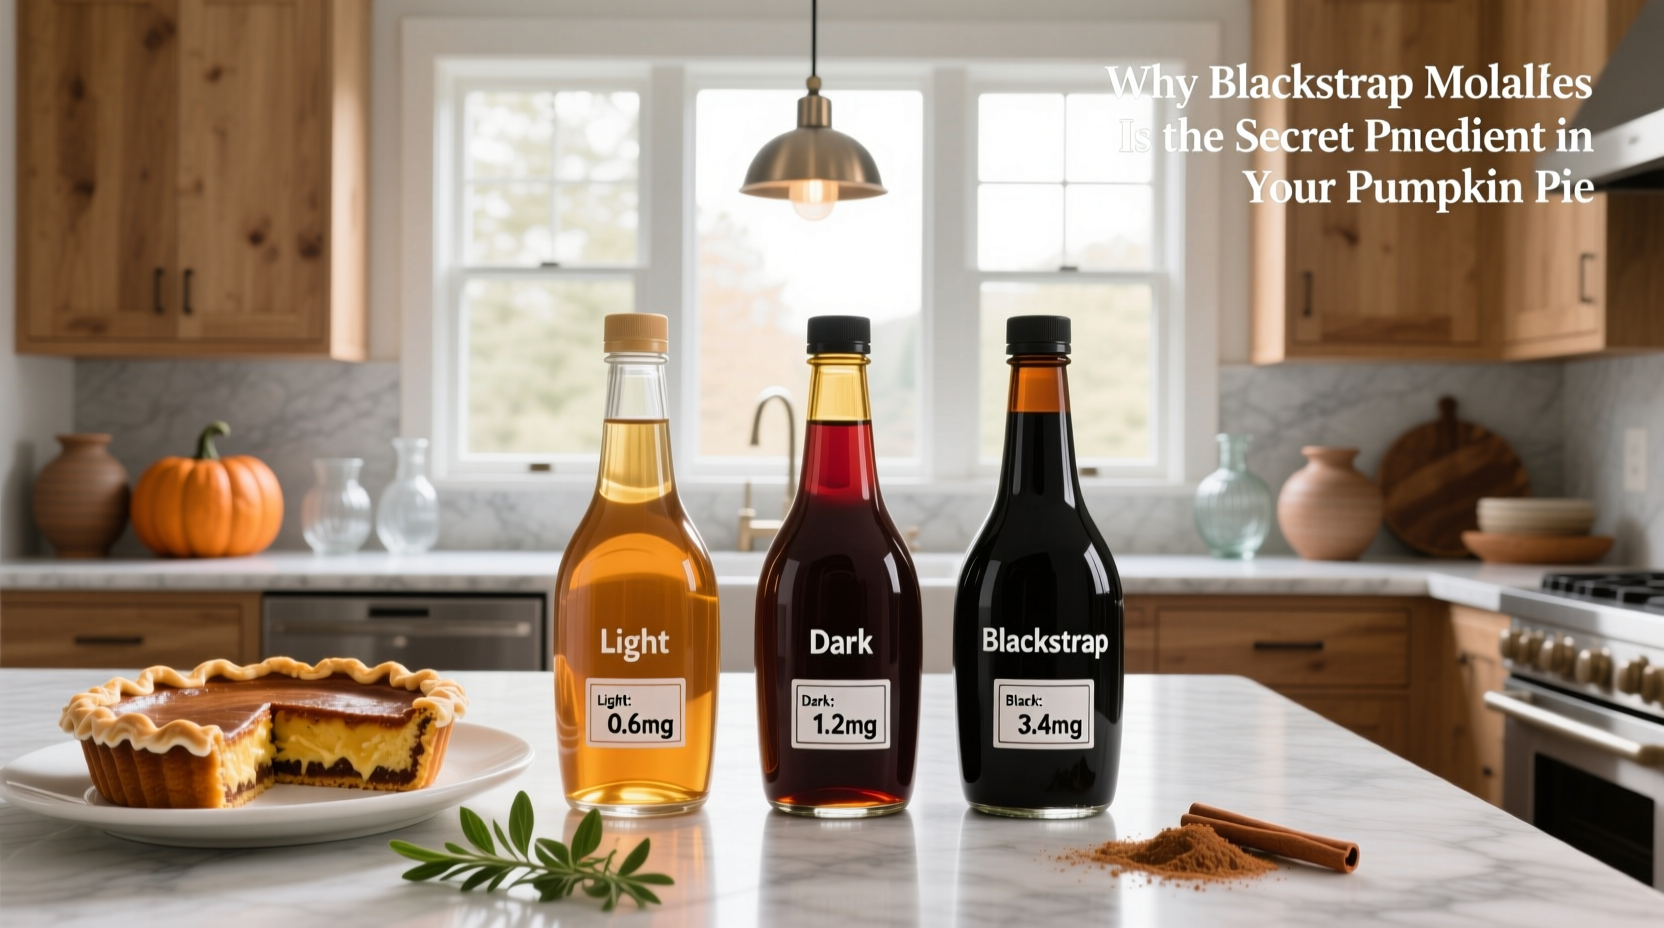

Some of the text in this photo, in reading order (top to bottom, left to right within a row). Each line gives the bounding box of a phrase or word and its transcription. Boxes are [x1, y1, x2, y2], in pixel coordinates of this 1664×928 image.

[601, 627, 670, 662] Light
[810, 627, 874, 655] Dark
[982, 627, 1109, 659] Blackstrap
[802, 694, 835, 707] Dark:
[1006, 694, 1043, 707] Black:
[607, 712, 674, 739] 0.6mg
[813, 713, 877, 740] 1.2mg
[1018, 713, 1082, 740] 3.4mg
